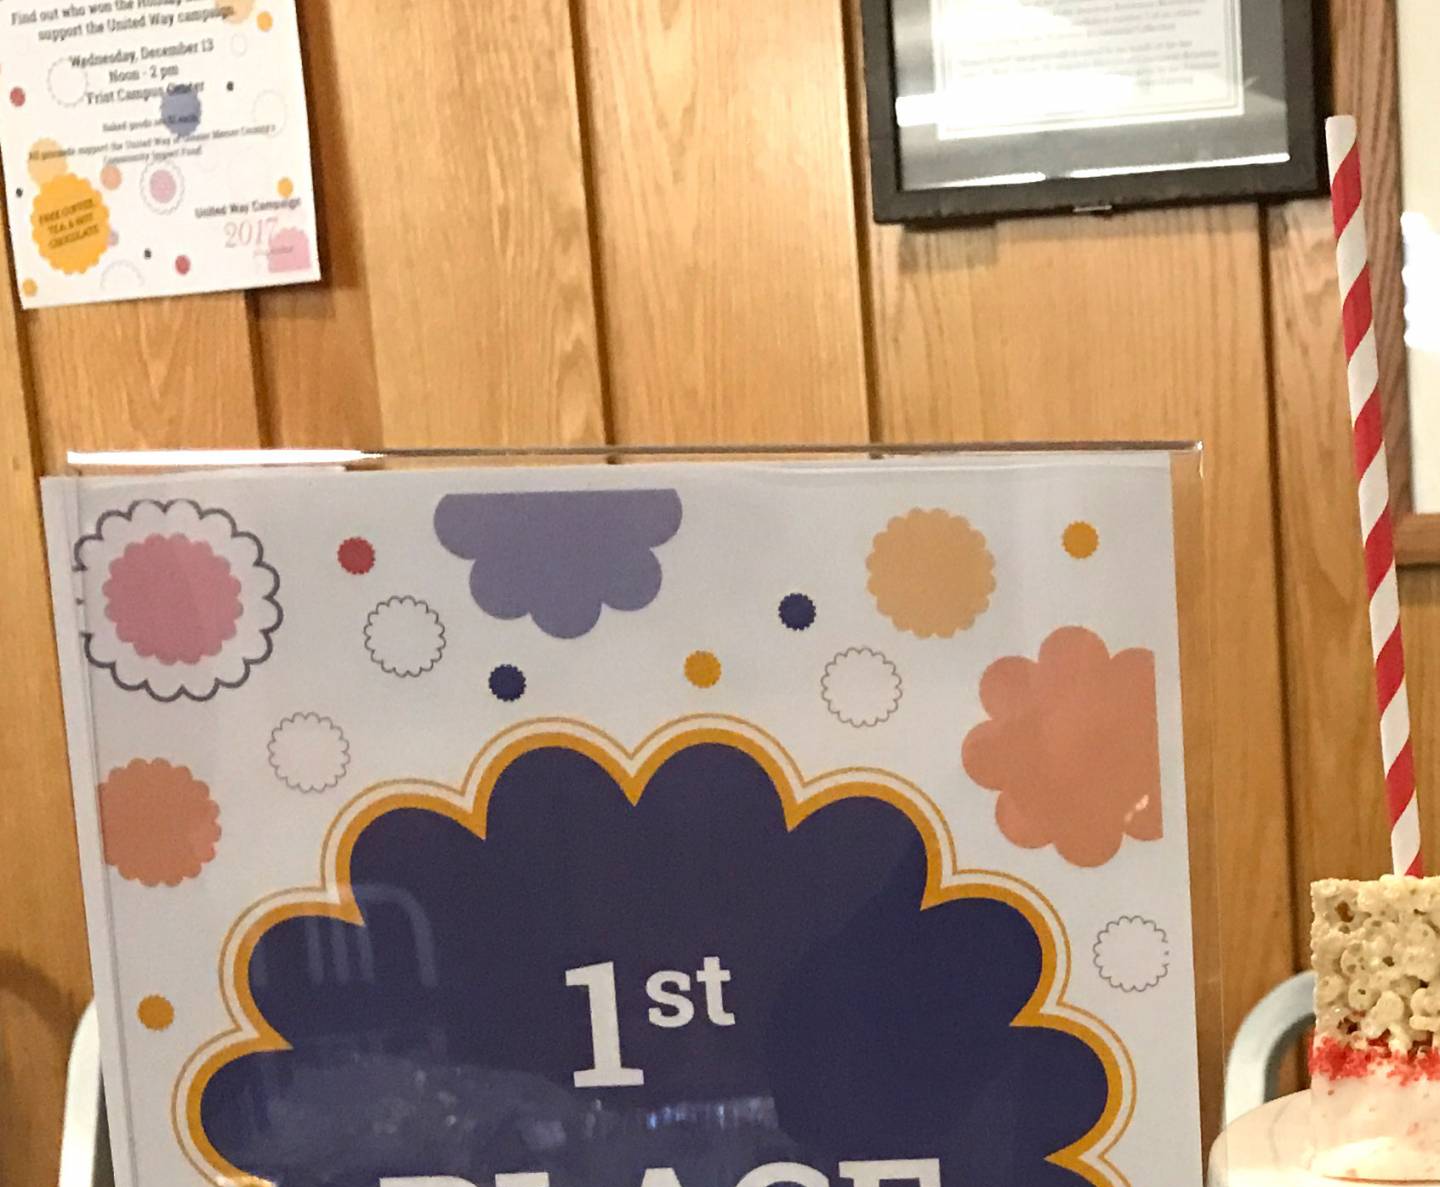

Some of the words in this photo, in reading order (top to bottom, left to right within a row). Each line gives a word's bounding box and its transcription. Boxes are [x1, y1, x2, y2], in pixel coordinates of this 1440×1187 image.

[11, 9, 37, 25] Find
[39, 8, 59, 21] out
[62, 4, 85, 17] who
[88, 2, 112, 14] won
[115, 0, 134, 11] the
[38, 25, 82, 41] support
[86, 20, 104, 34] the
[107, 15, 146, 31] United
[148, 13, 174, 27] Way
[69, 50, 138, 68] Wednesday,
[140, 41, 198, 60] December
[201, 38, 214, 53] 13
[109, 69, 140, 83] Noon
[149, 65, 157, 78] 2
[160, 65, 179, 80] pm
[117, 87, 164, 102] Campus
[78, 144, 108, 156] support
[111, 142, 123, 152] the
[126, 138, 151, 149] United
[154, 136, 170, 147] Way
[195, 205, 227, 219] United
[230, 203, 249, 215] Way
[252, 198, 301, 212] Campaign
[565, 956, 735, 1088] 1st
